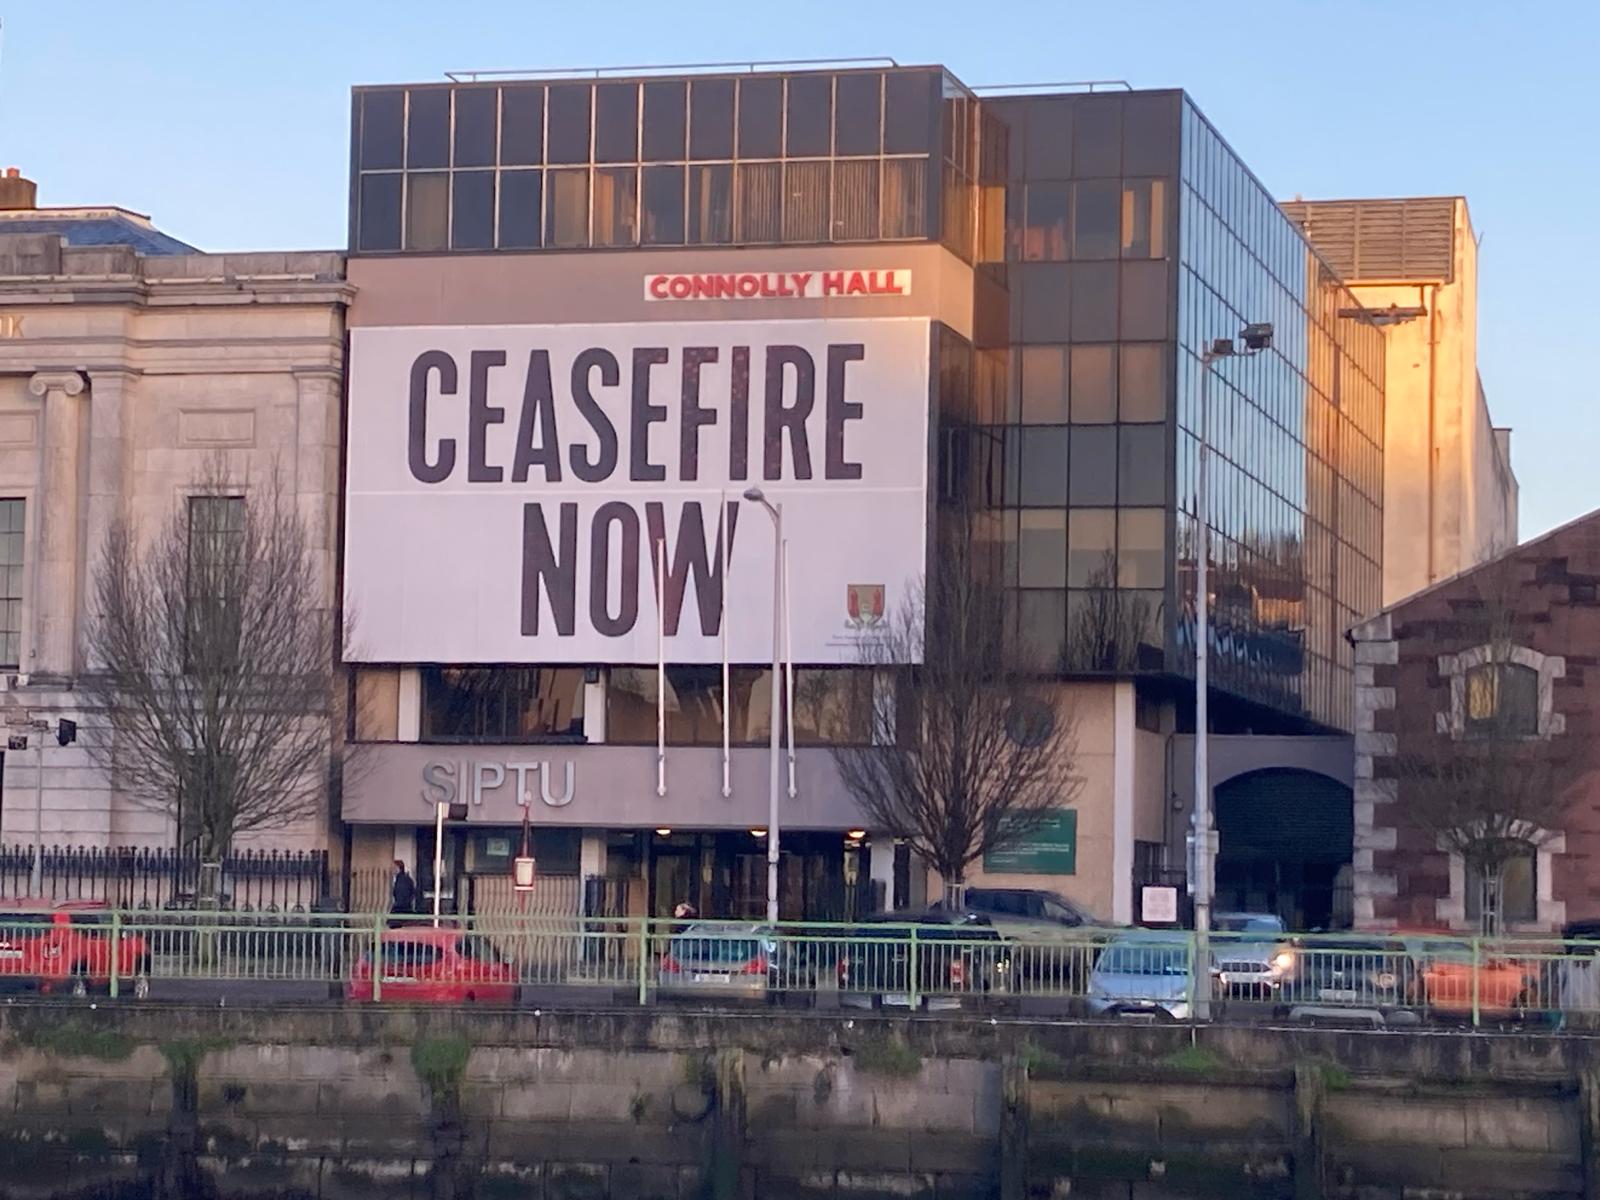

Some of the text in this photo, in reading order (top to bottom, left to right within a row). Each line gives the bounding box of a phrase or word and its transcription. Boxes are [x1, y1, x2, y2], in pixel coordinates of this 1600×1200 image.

[650, 271, 903, 299] CONNOLLY HALL
[407, 343, 865, 484] CEASEFIRE
[520, 501, 740, 638] NOW
[421, 760, 576, 808] SIPTU
